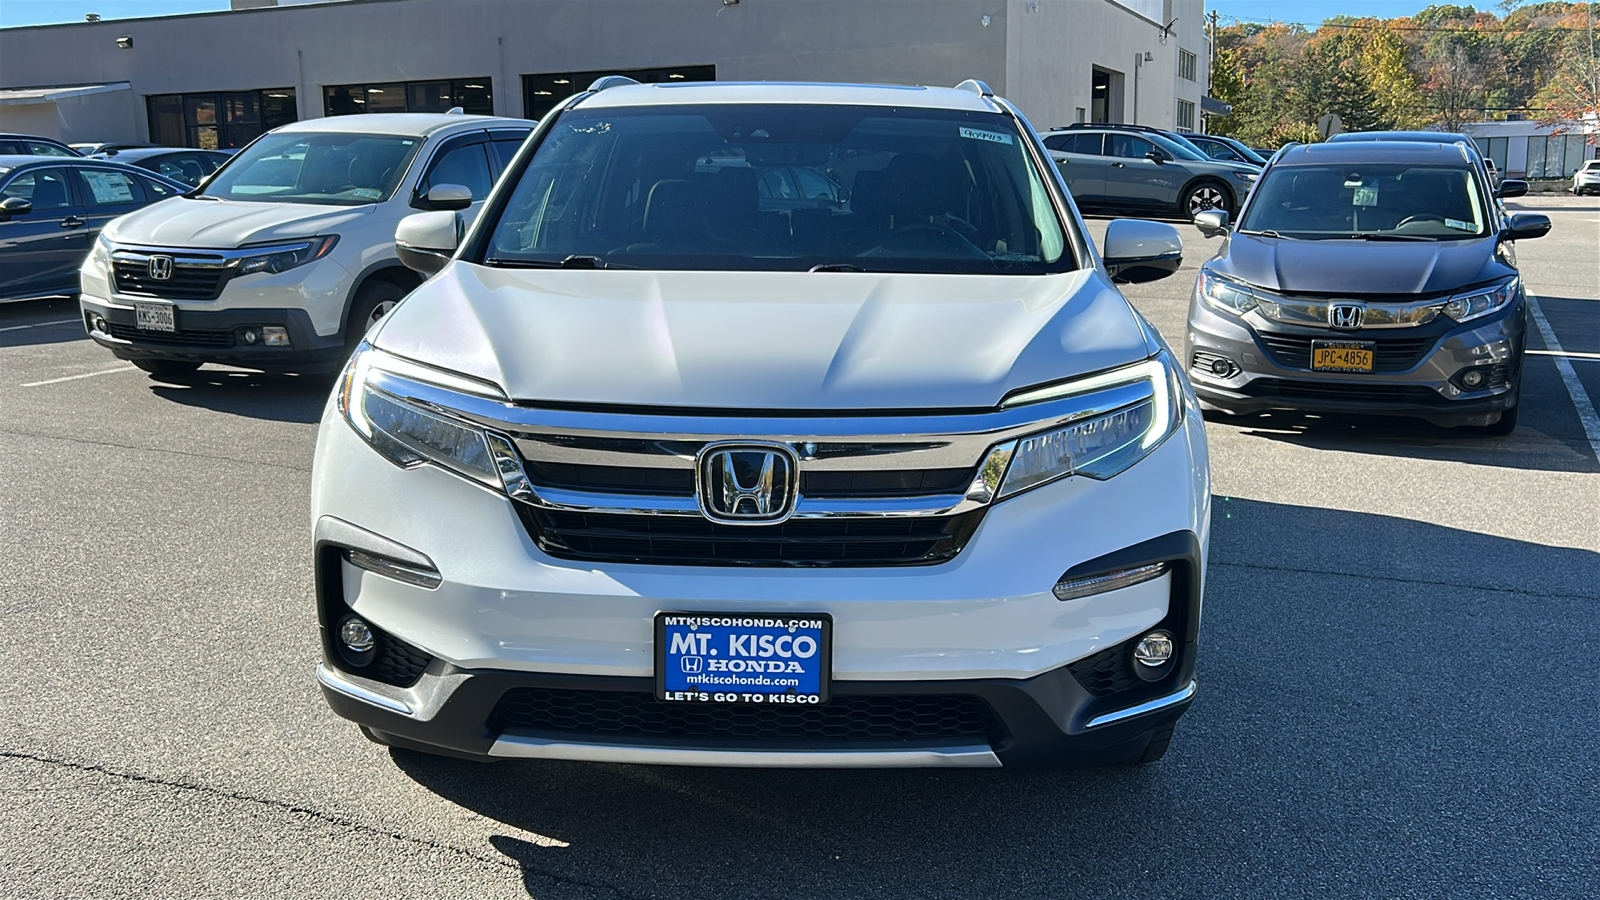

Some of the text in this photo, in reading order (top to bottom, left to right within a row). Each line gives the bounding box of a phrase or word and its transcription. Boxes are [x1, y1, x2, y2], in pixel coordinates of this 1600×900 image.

[665, 616, 822, 629] MTKISCOHONDA.COM
[669, 632, 817, 659] MT. KISCO
[707, 659, 805, 674] HONDA
[686, 674, 799, 686] mtkiscohonda.com
[665, 691, 820, 704] LET'S GO TO KISCO
